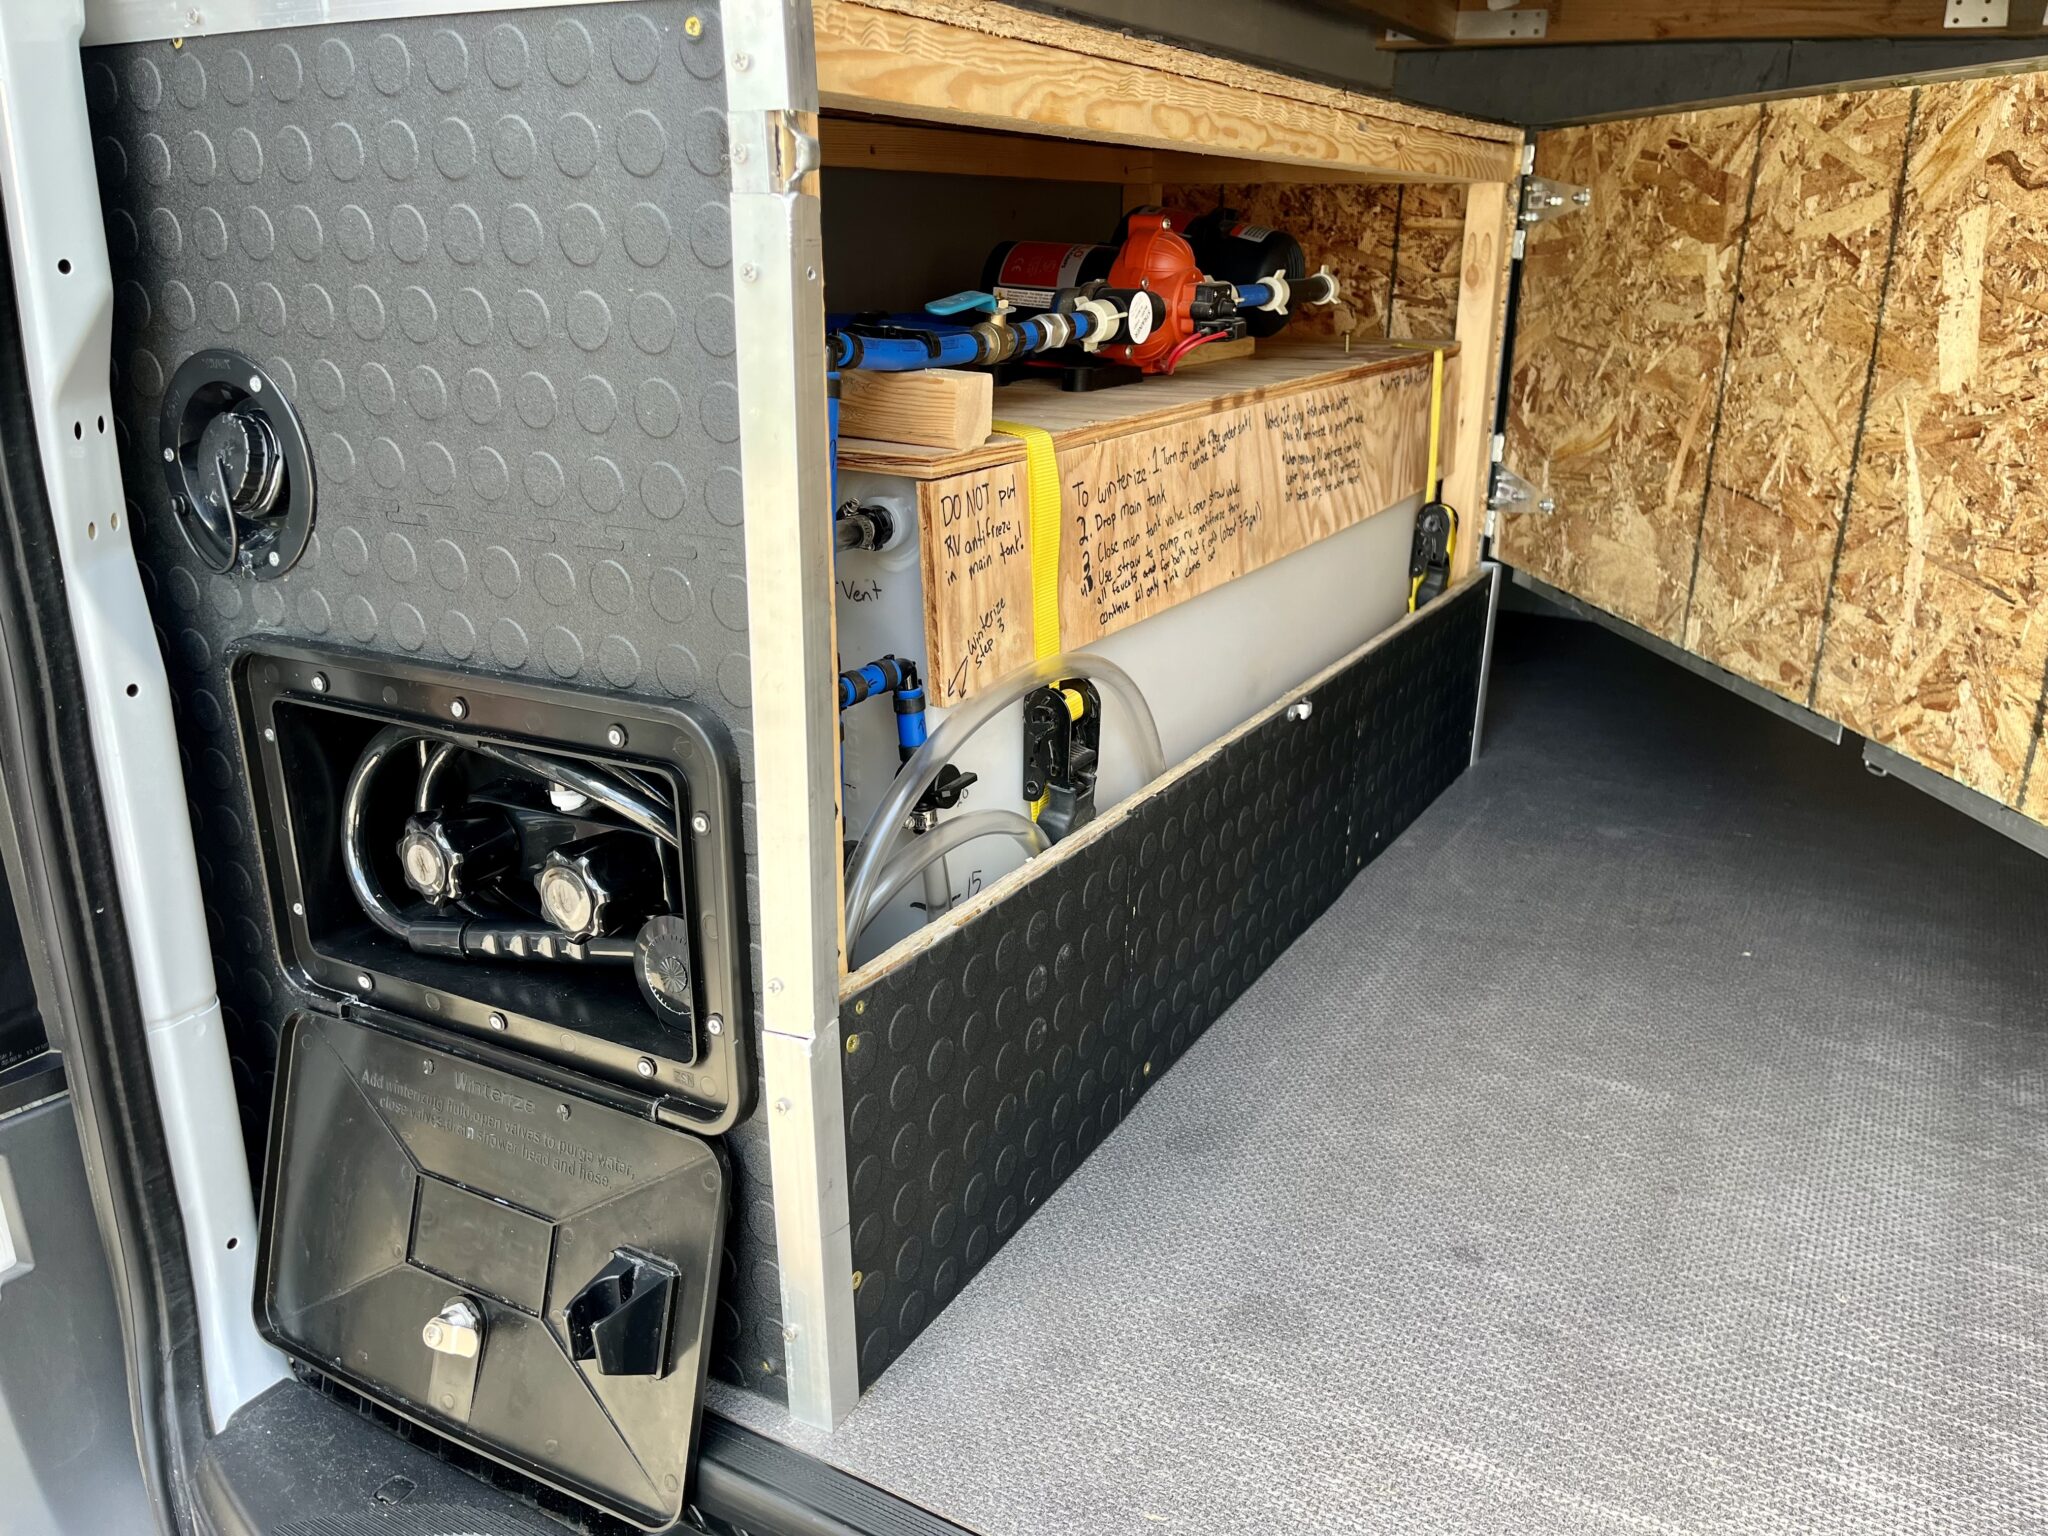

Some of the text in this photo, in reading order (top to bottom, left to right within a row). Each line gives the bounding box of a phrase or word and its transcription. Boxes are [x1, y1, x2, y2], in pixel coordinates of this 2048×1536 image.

[941, 474, 1016, 527] DO NOT put
[1072, 481, 1088, 507] To
[1095, 513, 1116, 532] Drop
[1147, 484, 1166, 506] tank
[944, 517, 1012, 559] RV antifreeze
[1097, 541, 1119, 563] Close
[1146, 514, 1161, 538] tank
[1099, 568, 1112, 585] Use
[1117, 556, 1141, 578] straw
[1146, 545, 1153, 559] to
[1160, 536, 1179, 560] pump
[841, 580, 882, 602] Vent
[945, 569, 957, 586] in
[969, 556, 992, 582] main
[1097, 588, 1107, 605] all
[361, 1068, 384, 1089] Add
[386, 1080, 444, 1113] winterizing
[505, 1121, 540, 1144] valves
[543, 1132, 556, 1149] to
[558, 1140, 594, 1163] purge
[598, 1153, 636, 1180] water,
[380, 1096, 407, 1115] close
[478, 1130, 517, 1154] shower
[521, 1144, 550, 1166] head
[553, 1158, 576, 1176] and
[579, 1164, 612, 1190] hose.
